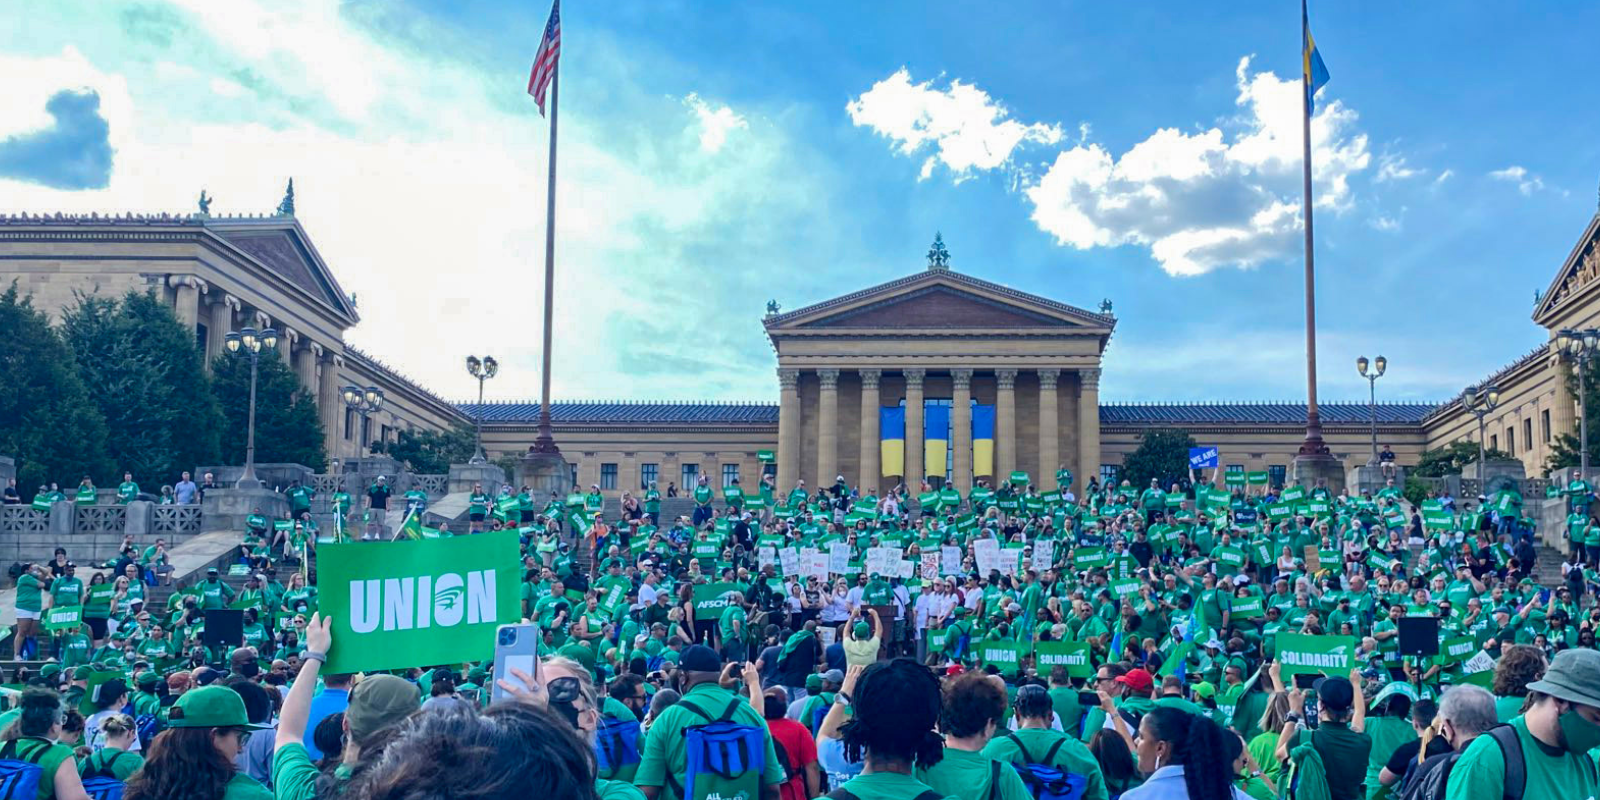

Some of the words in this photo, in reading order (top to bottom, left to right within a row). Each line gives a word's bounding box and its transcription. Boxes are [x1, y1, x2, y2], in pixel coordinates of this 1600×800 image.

[1190, 457, 1203, 465] WE
[1203, 449, 1217, 460] ARE
[1115, 583, 1139, 594] UNION
[350, 569, 496, 633] UNION
[52, 612, 79, 623] UNION
[985, 649, 1016, 662] UNION
[1448, 641, 1474, 656] UNION
[1040, 655, 1085, 666] SOLIDARITY
[1280, 650, 1348, 668] SOLIDARITY
